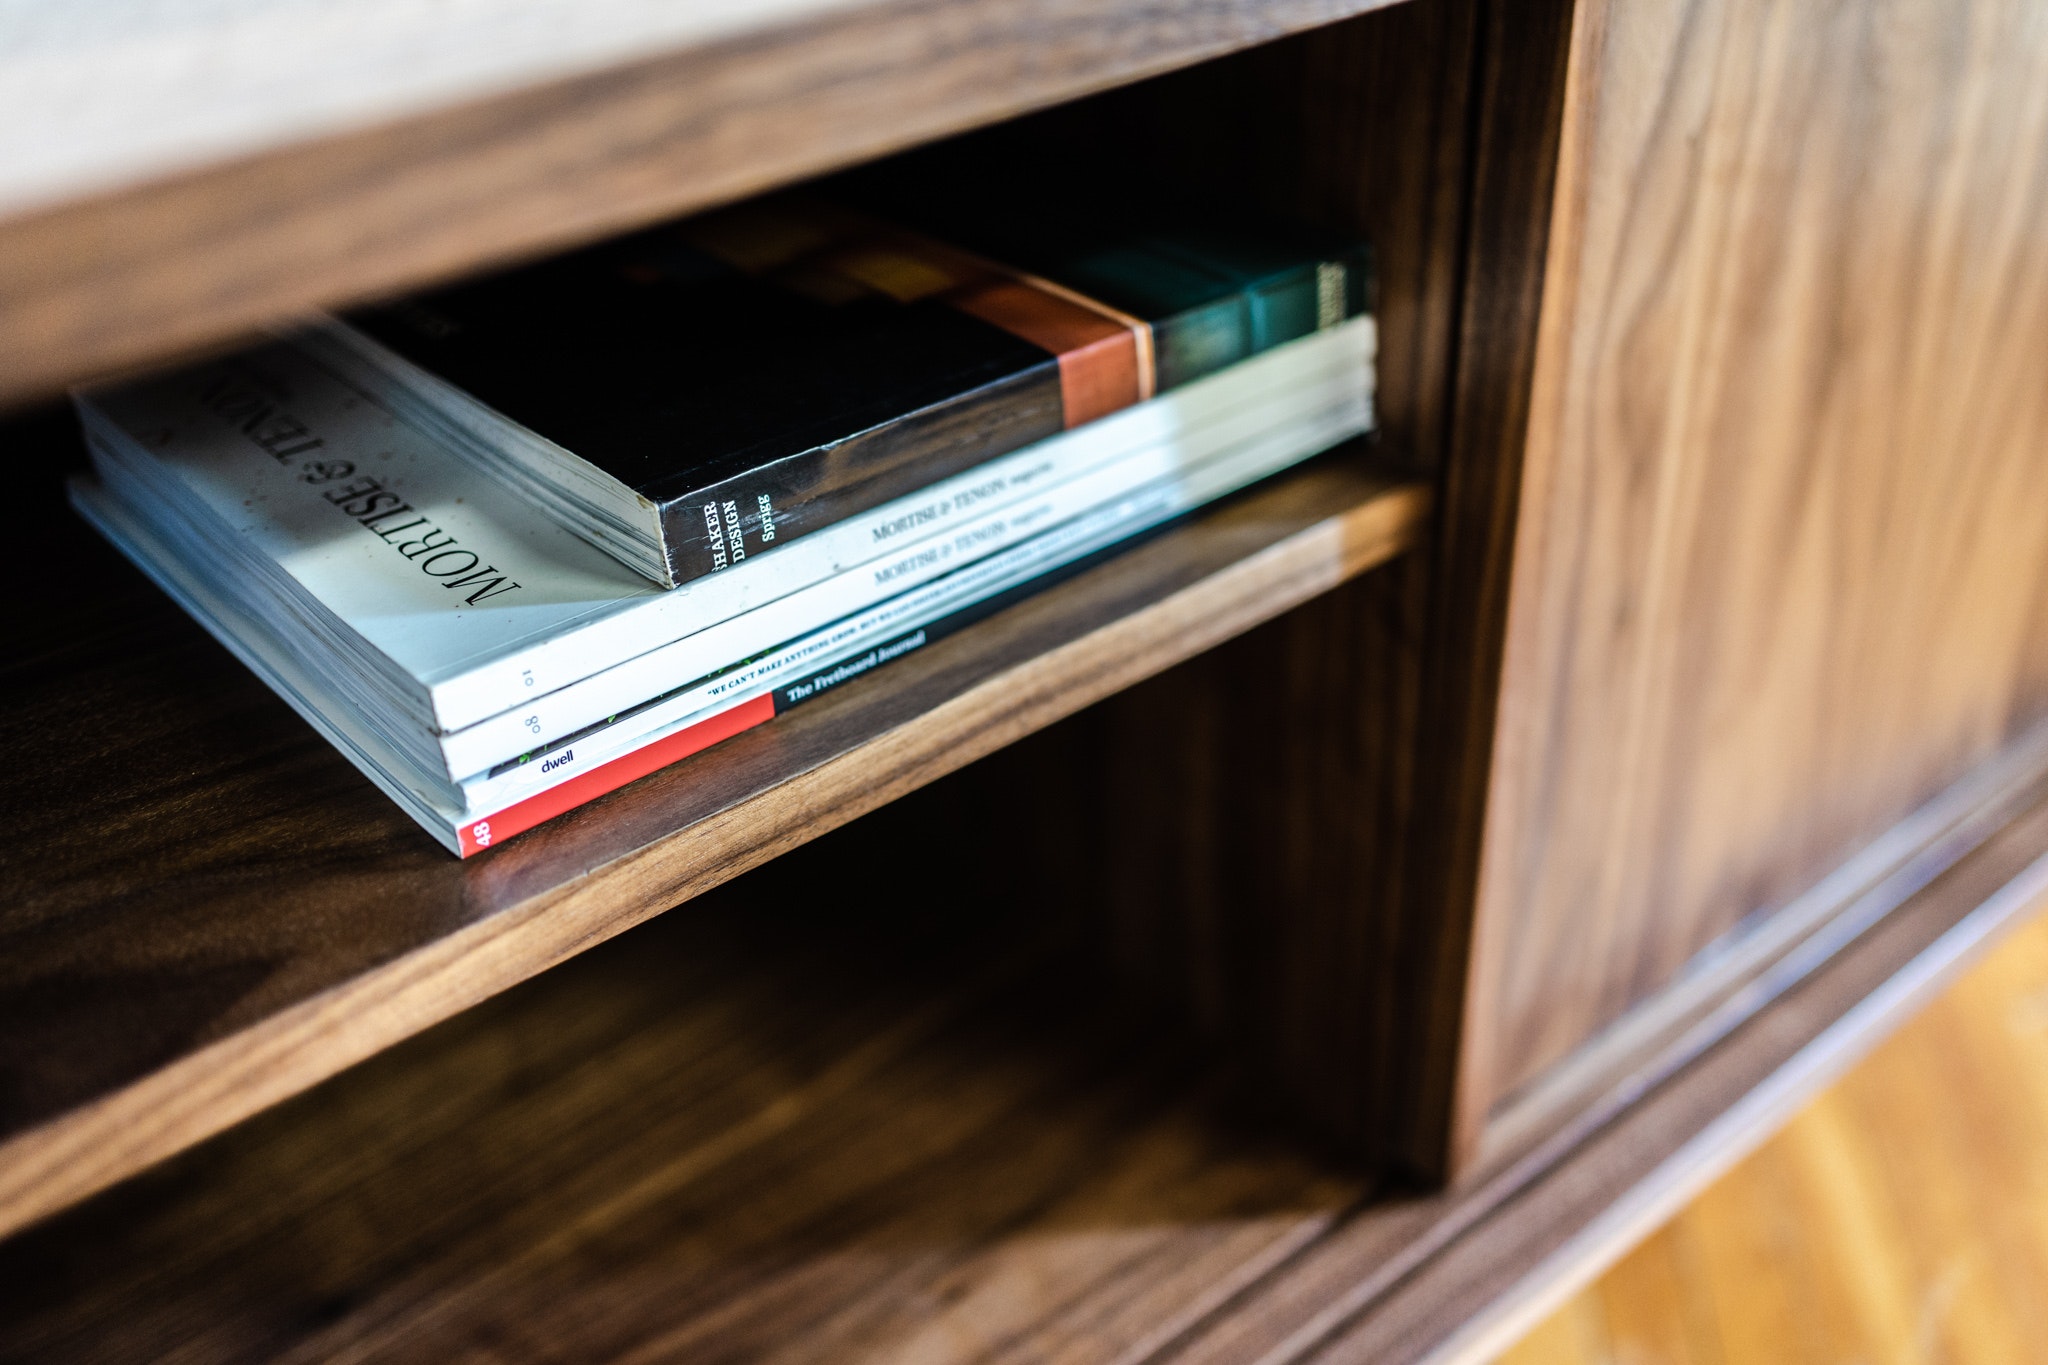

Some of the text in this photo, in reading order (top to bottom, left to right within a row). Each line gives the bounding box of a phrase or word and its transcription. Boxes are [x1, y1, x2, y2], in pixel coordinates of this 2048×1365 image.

[301, 458, 356, 485] &
[722, 500, 745, 563] DESIGN
[758, 494, 775, 542] Sprigg
[322, 475, 522, 607] MORTISE
[728, 671, 756, 689] CAN'T
[757, 660, 783, 676] MAKE
[786, 683, 813, 702] The
[541, 750, 574, 774] dwell
[473, 821, 493, 847] 48
